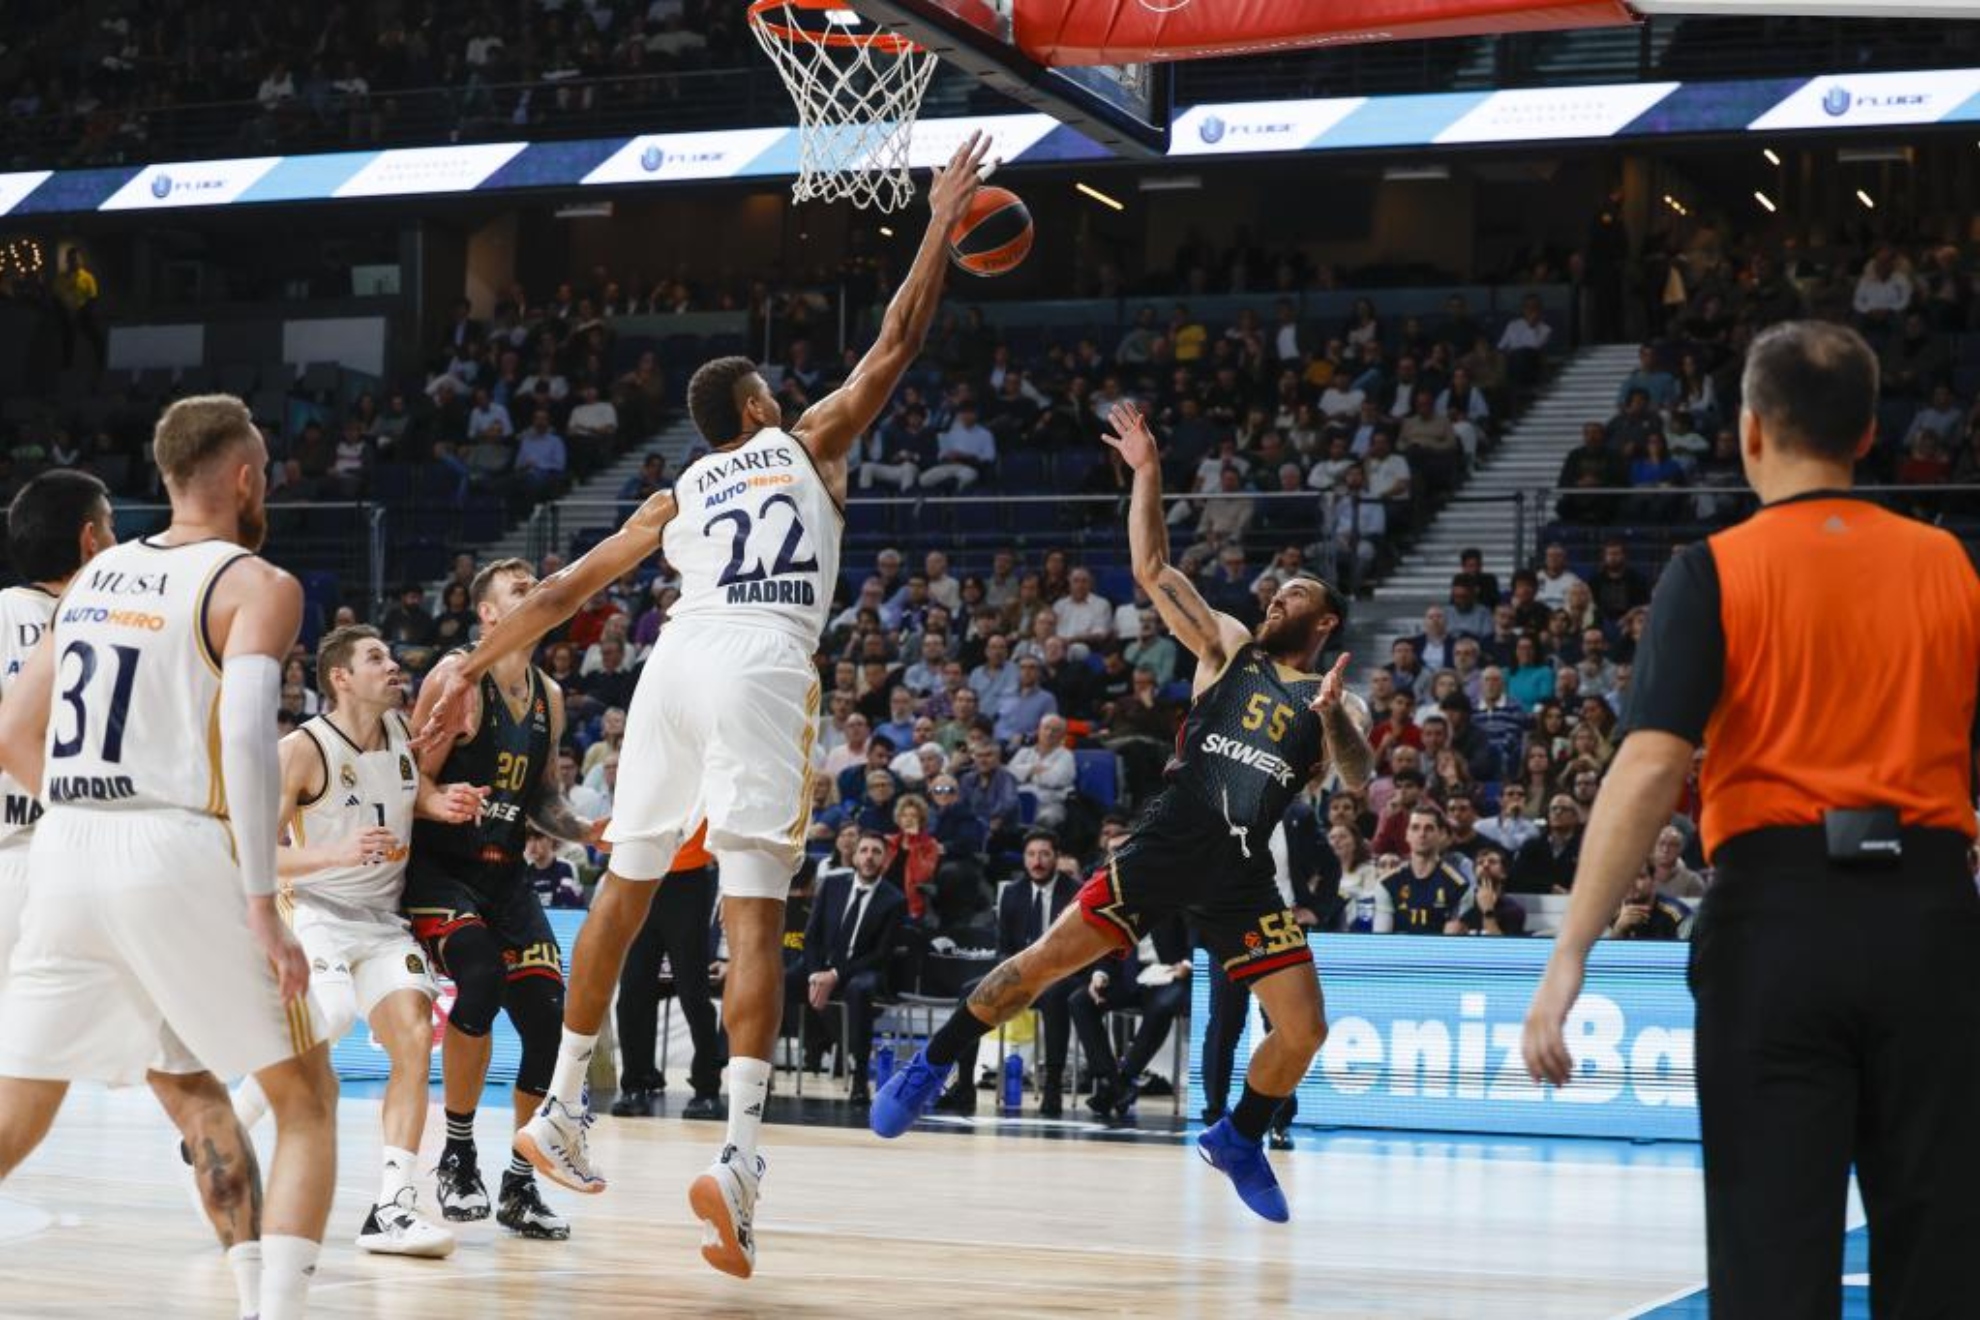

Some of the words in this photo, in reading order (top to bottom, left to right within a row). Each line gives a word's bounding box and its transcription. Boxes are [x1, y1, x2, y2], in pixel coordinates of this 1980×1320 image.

[697, 448, 793, 493] TAVARES
[705, 474, 793, 509] AUTOHERO
[703, 493, 819, 587] 22
[91, 570, 168, 596] MUSA
[726, 580, 815, 606] MADRID
[62, 607, 165, 632] AUTOHERO
[52, 640, 141, 764] 31
[1242, 692, 1295, 742] 55
[494, 751, 529, 791] 20
[1249, 992, 1698, 1107] enizBa
